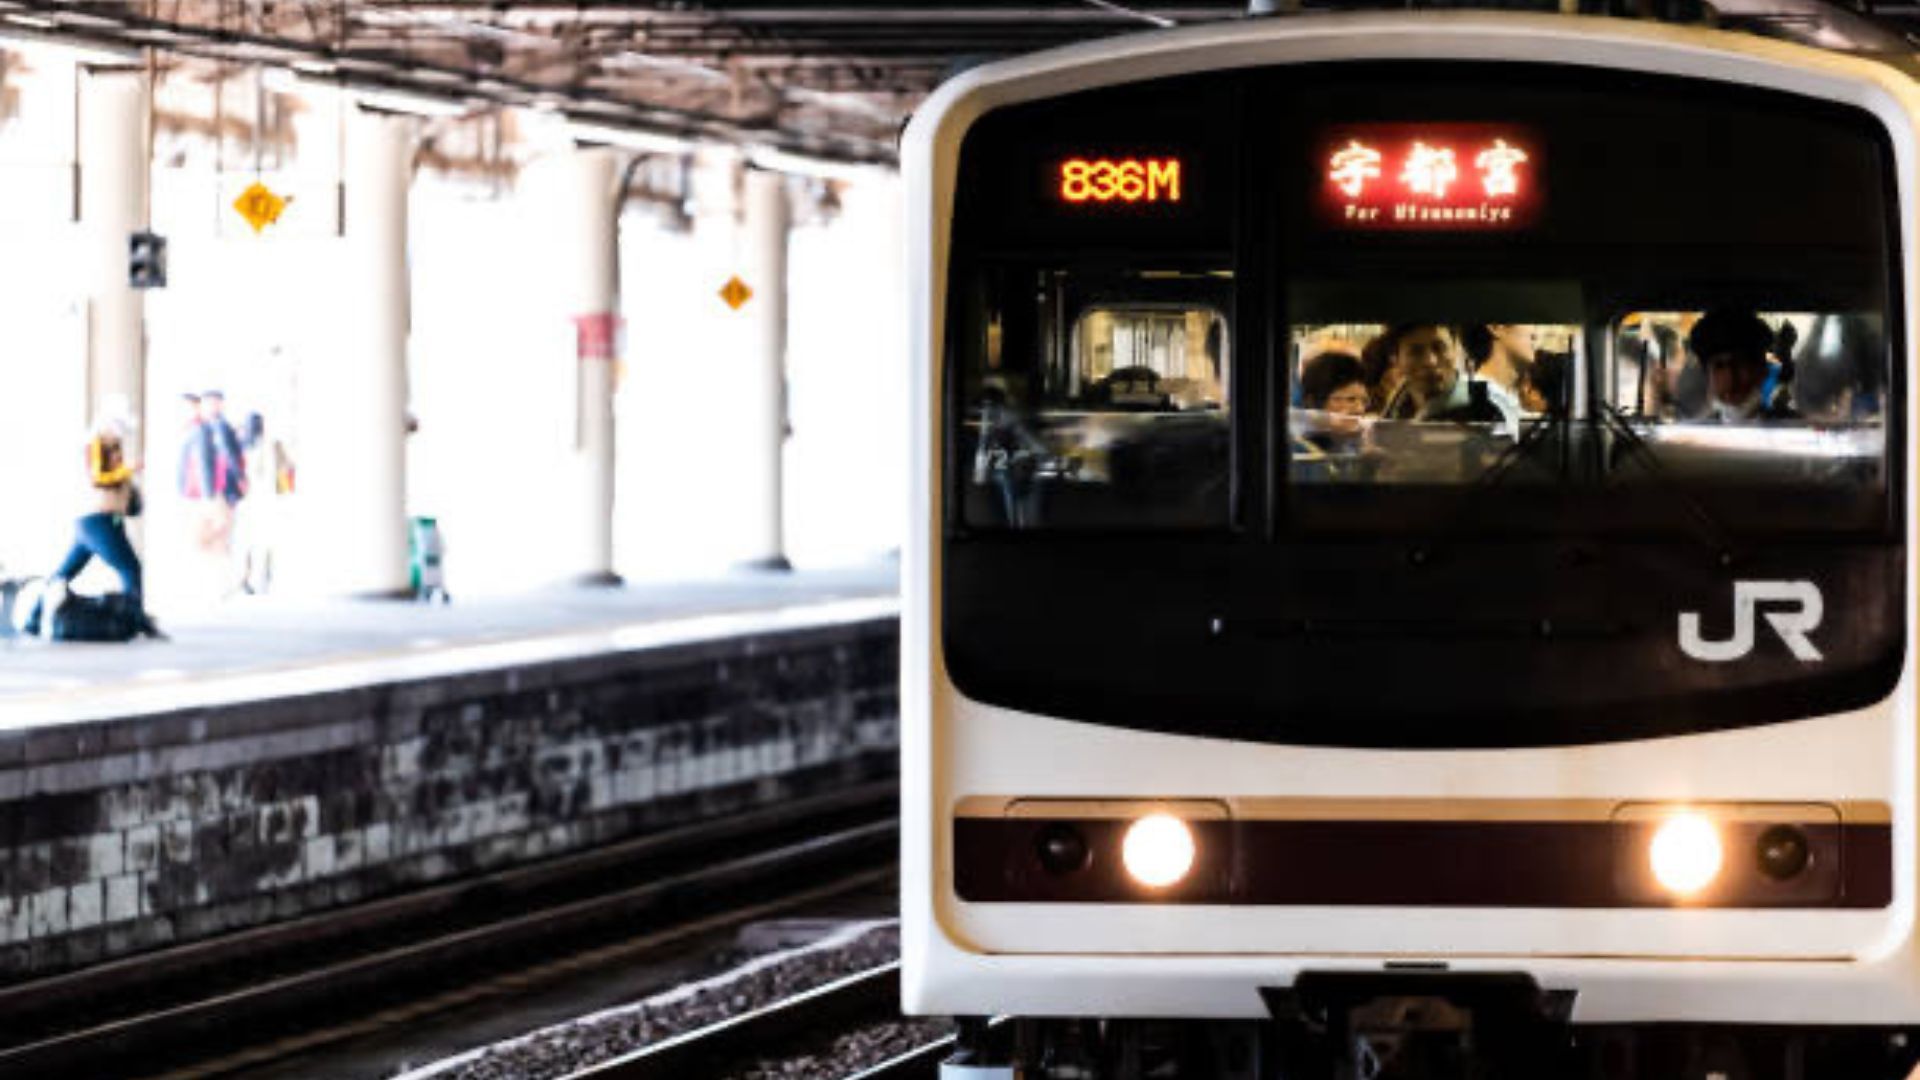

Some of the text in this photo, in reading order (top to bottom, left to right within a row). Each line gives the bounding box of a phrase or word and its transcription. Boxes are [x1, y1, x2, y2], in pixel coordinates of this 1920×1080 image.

[1062, 159, 1180, 201] 836M
[1329, 139, 1528, 199] 宇都宮
[1345, 204, 1379, 220] For
[1678, 580, 1824, 662] JR
